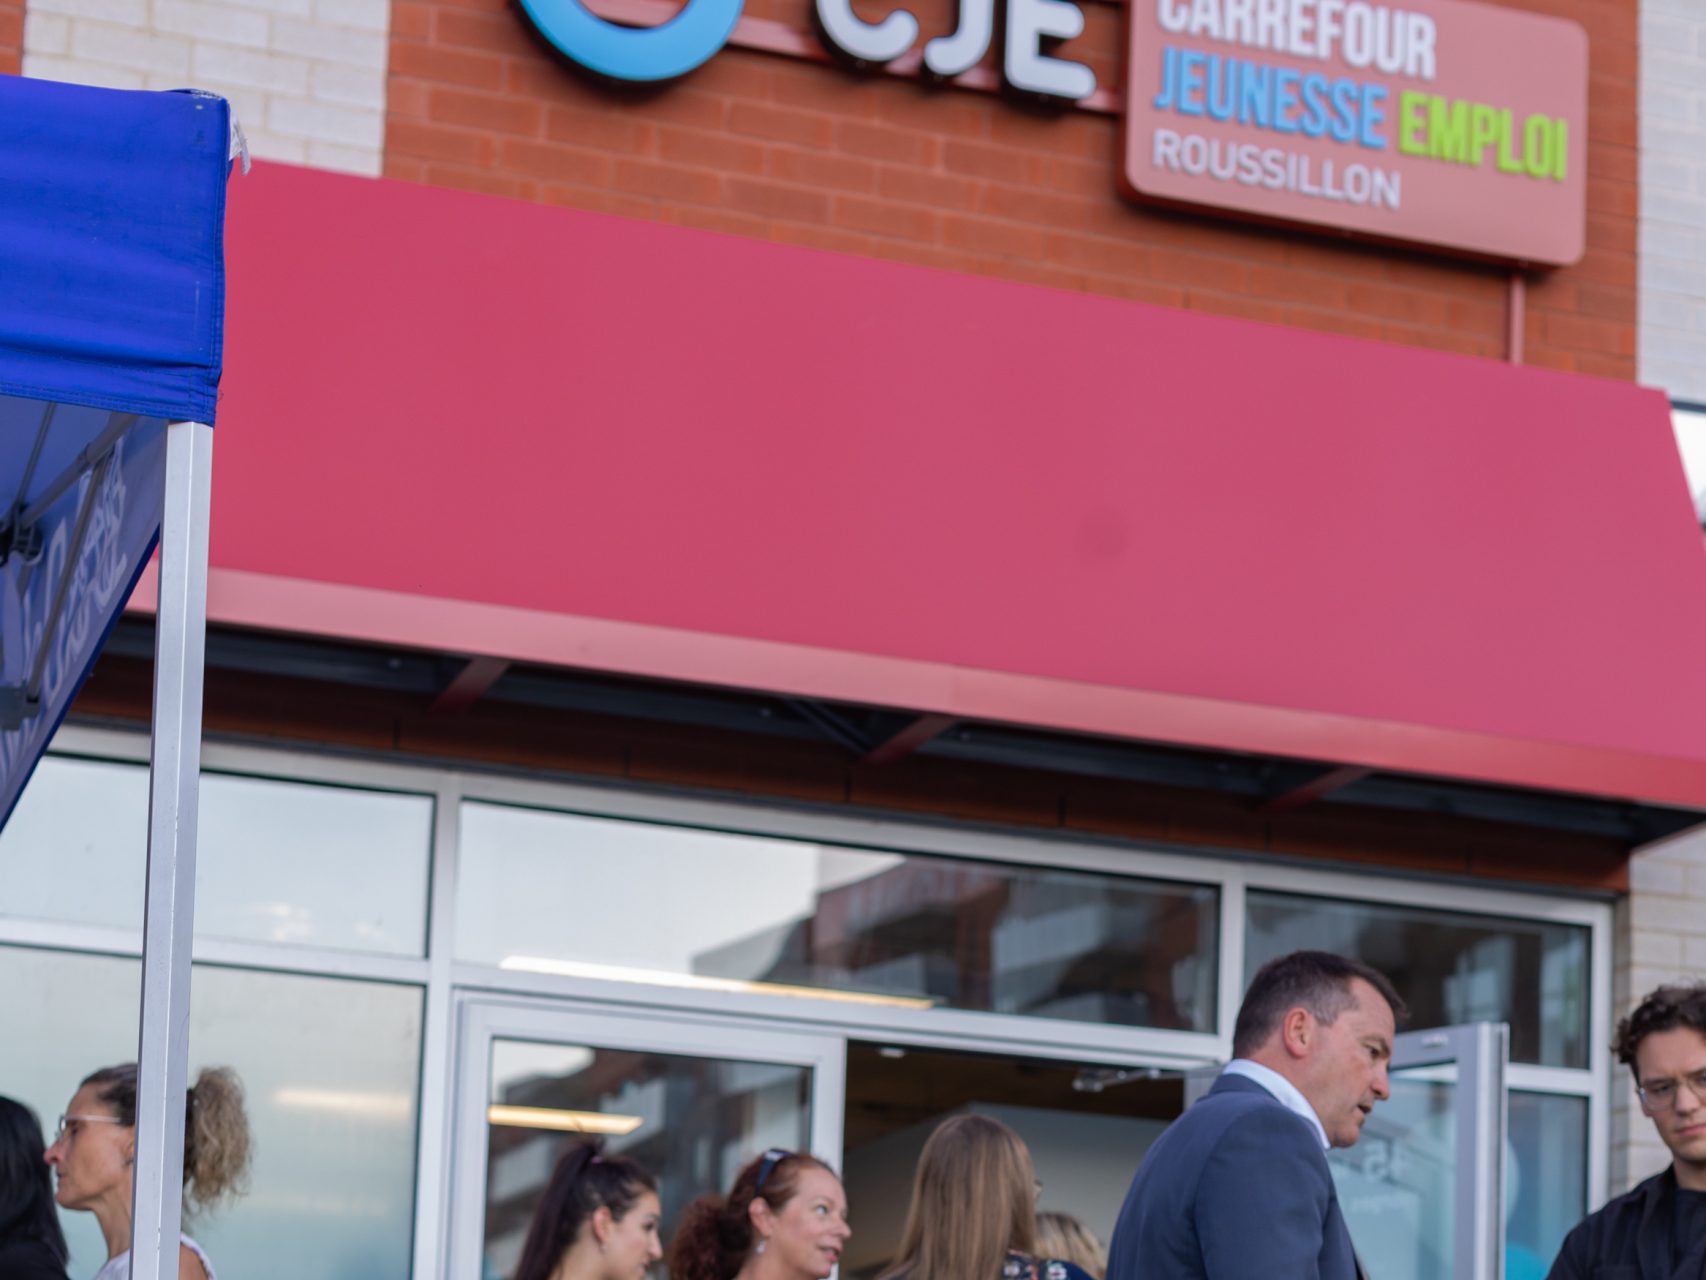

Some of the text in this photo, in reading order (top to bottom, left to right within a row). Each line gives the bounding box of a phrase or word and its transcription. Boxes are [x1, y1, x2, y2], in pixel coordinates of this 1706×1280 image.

[1156, 0, 1437, 80] CARREFOUR
[1153, 46, 1569, 181] JEUNESSE EMPLOI
[1152, 129, 1400, 208] ROUSSILLON
